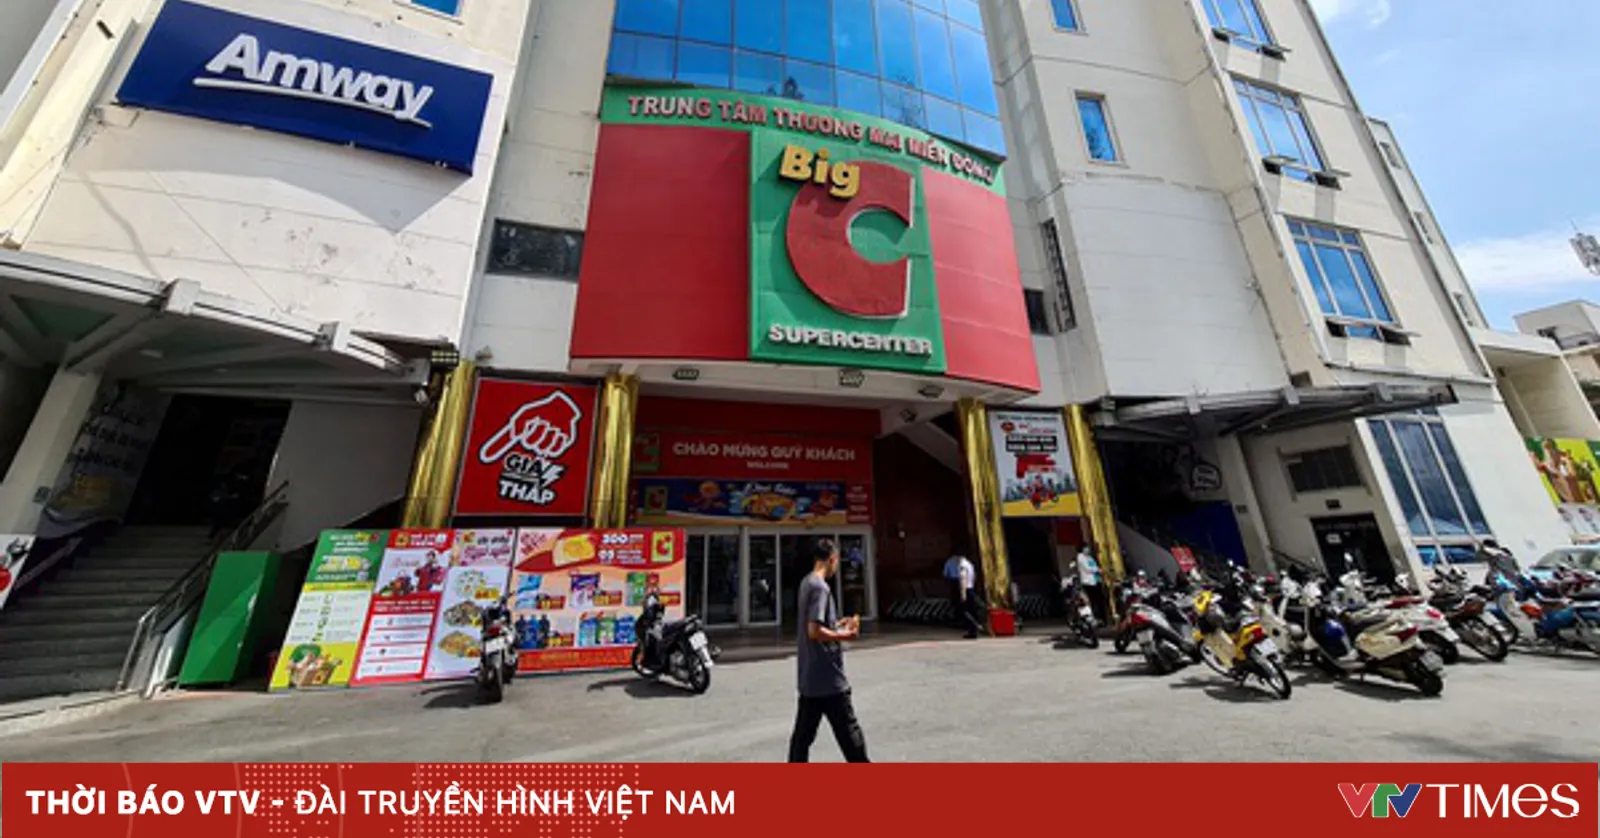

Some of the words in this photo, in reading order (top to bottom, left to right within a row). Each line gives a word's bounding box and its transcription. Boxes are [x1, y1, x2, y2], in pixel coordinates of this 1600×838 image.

[205, 33, 434, 119] Amway
[628, 95, 712, 119] TRUNG
[718, 100, 767, 124] TÂM
[779, 144, 860, 198] Big
[786, 160, 915, 319] C
[769, 323, 933, 355] SUPERCENTER
[672, 440, 720, 456] CHÀO
